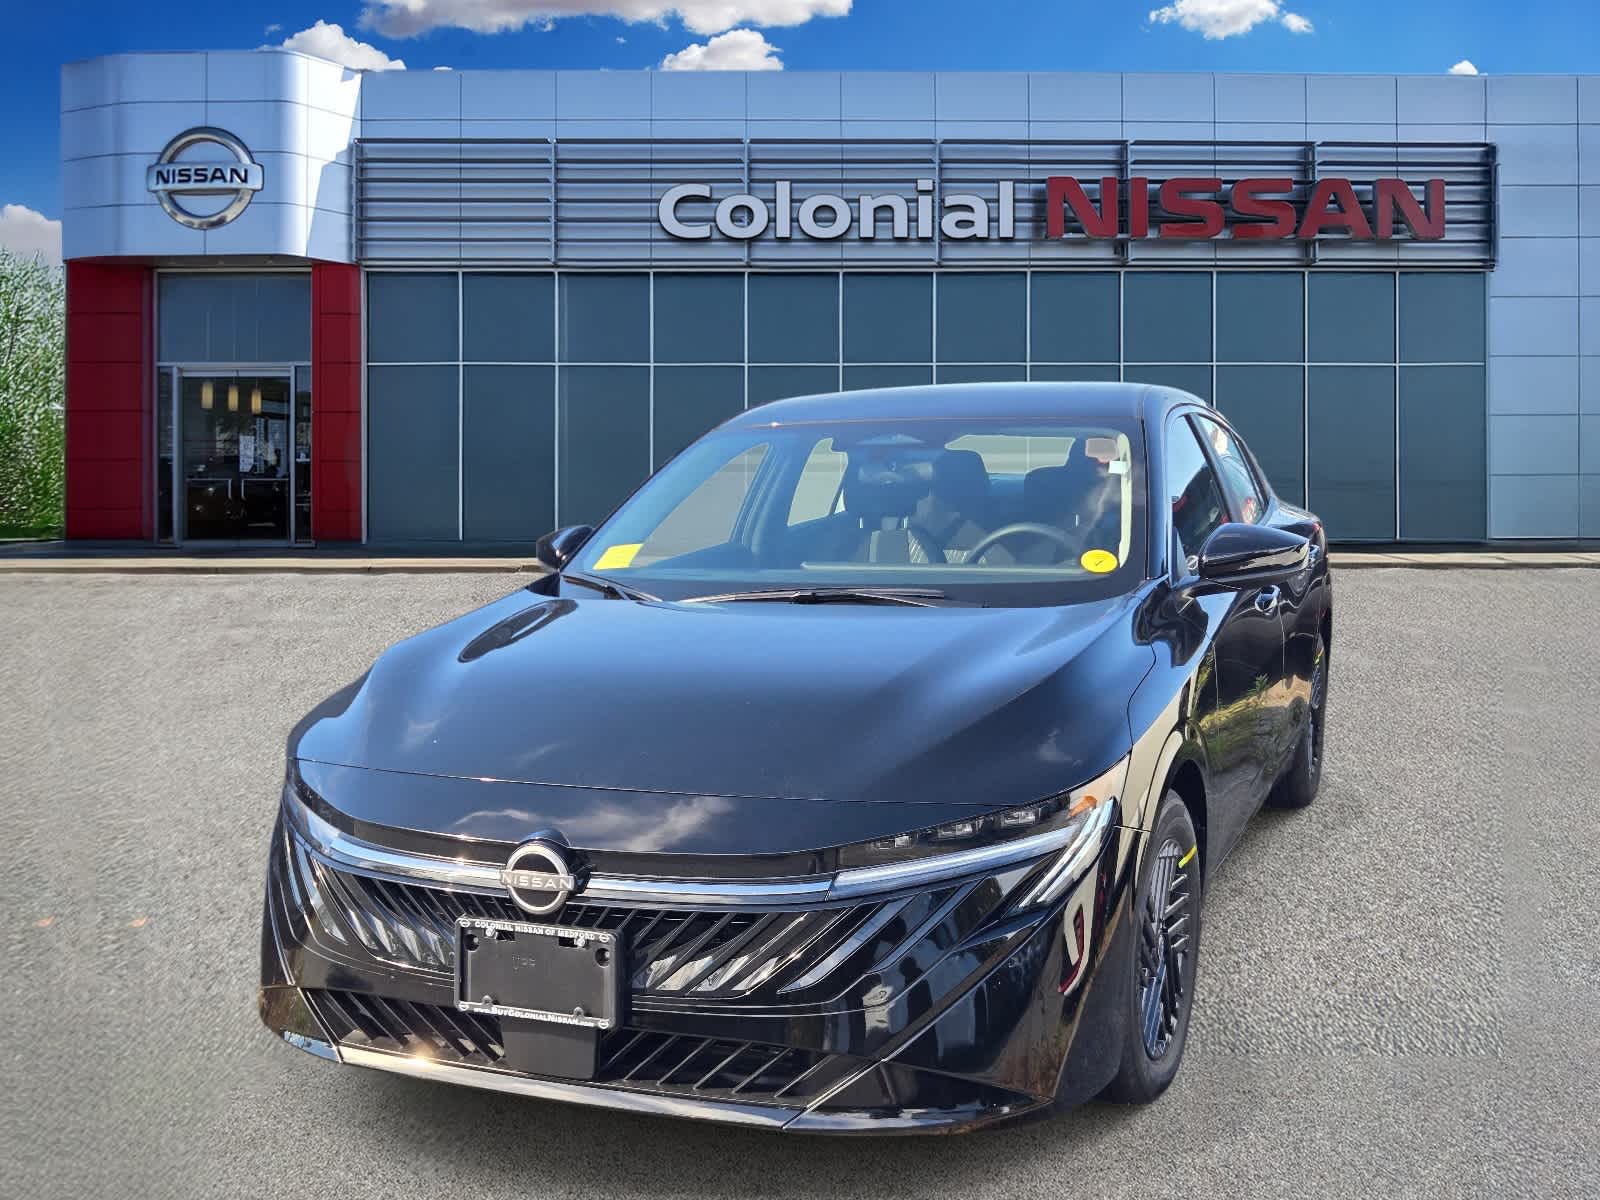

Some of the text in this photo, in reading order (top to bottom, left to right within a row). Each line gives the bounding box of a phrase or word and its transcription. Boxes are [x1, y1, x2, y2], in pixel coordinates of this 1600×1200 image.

[155, 167, 248, 185] NISSAN
[658, 176, 1446, 241] Colonial NISSAN
[501, 873, 573, 889] NISSAN
[474, 920, 514, 932] COLONIAL
[514, 924, 544, 936] NISSAN
[544, 928, 556, 936] OF
